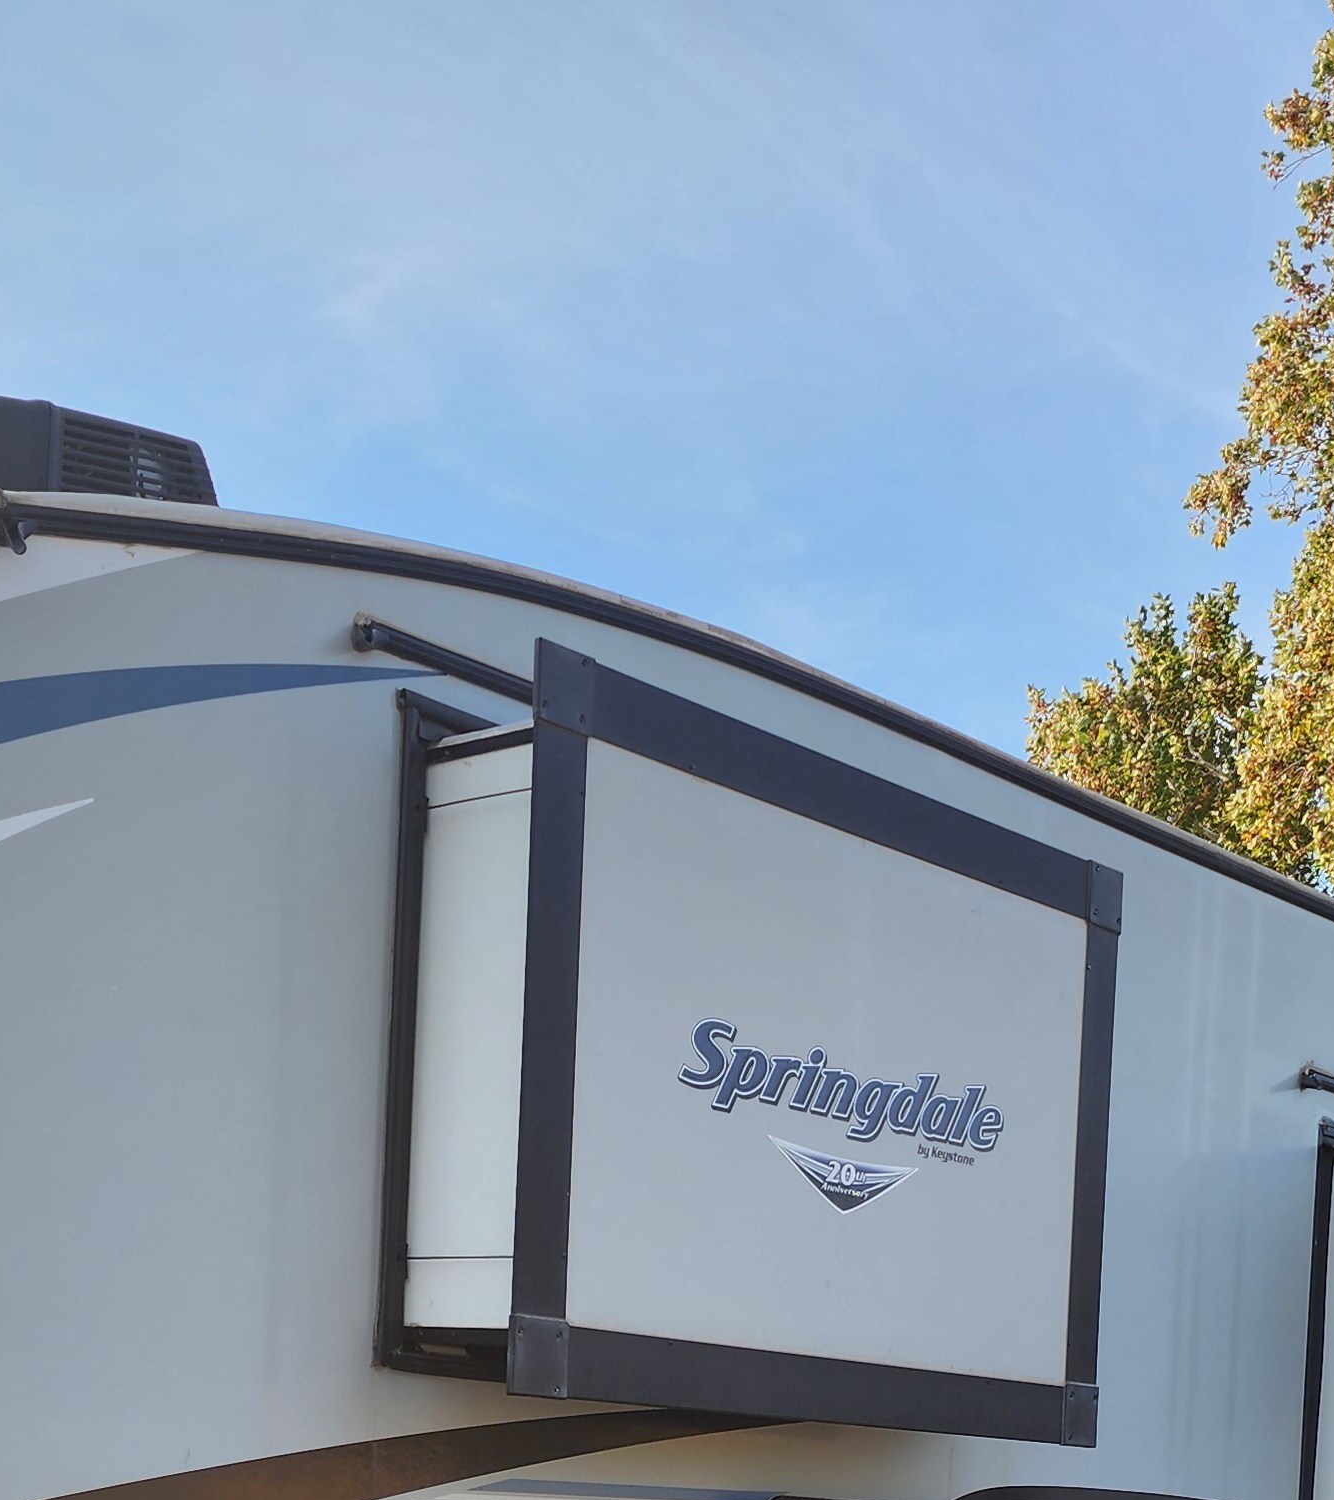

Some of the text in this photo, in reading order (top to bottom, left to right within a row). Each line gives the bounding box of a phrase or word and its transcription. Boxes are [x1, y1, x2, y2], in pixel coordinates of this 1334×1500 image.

[677, 1017, 1005, 1152] Springdale
[917, 1143, 976, 1166] by Keystone
[824, 1160, 867, 1187] 20th
[819, 1181, 870, 1200] Anniversary
